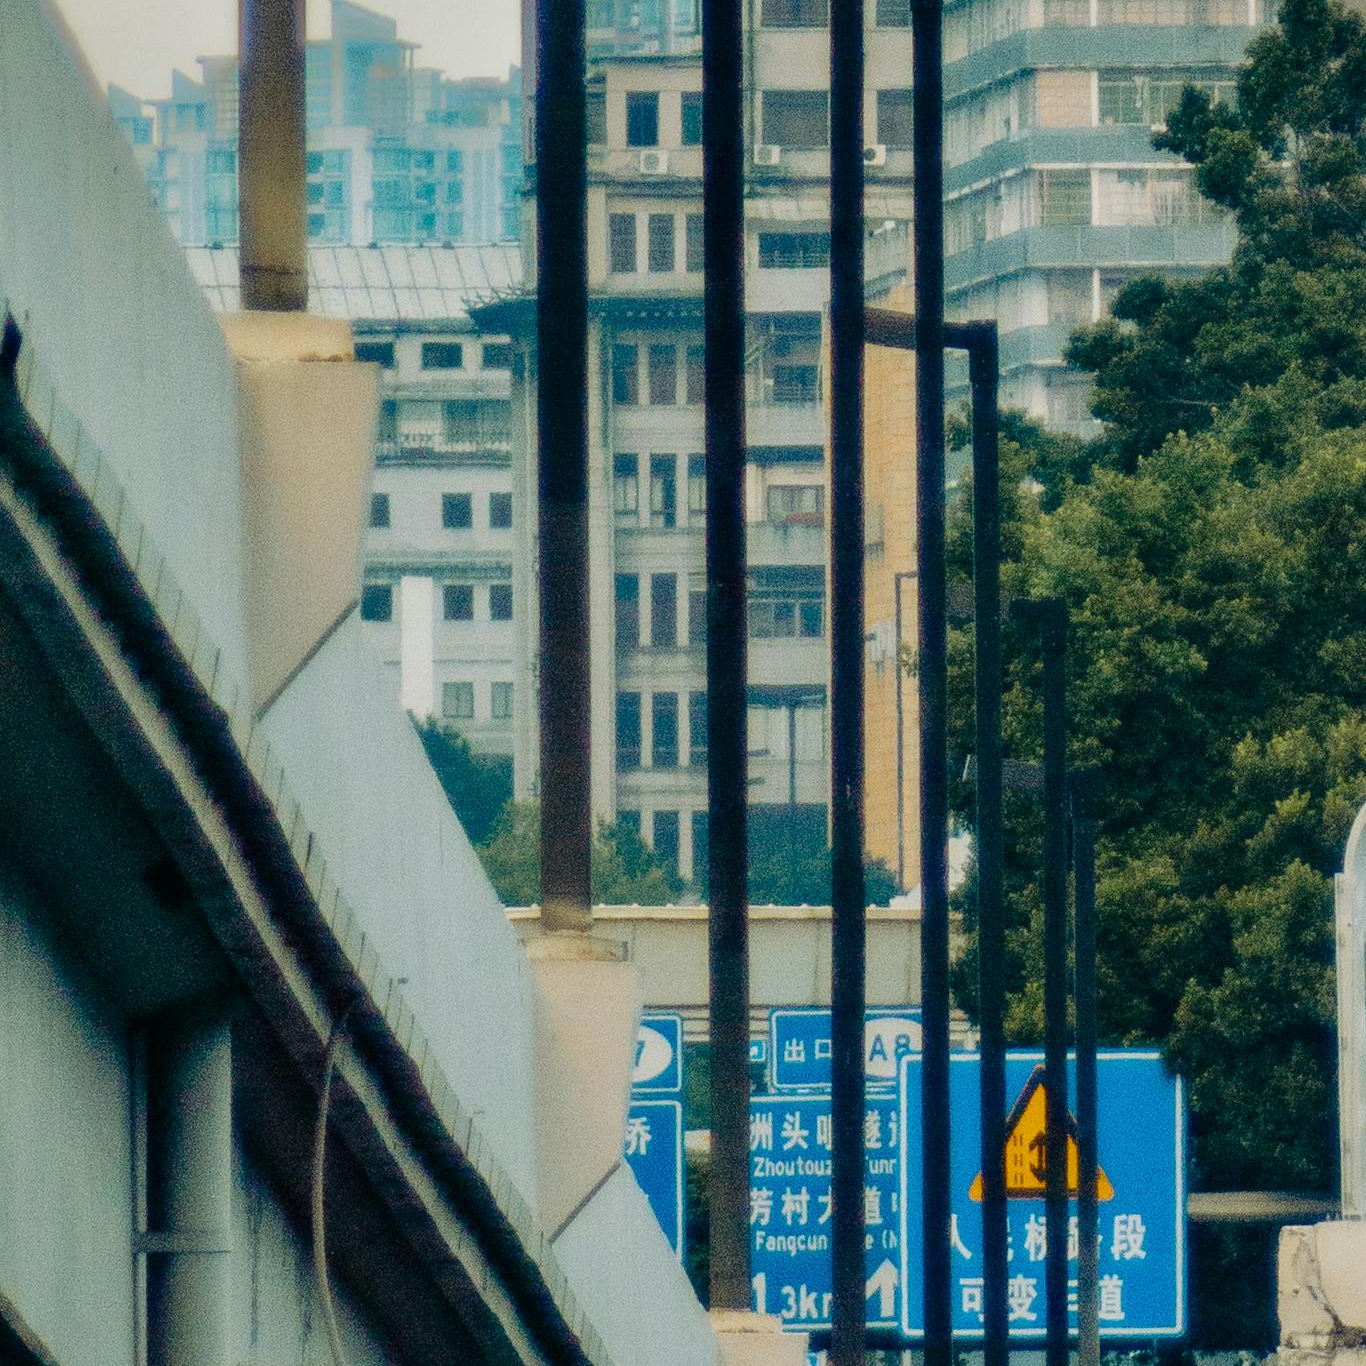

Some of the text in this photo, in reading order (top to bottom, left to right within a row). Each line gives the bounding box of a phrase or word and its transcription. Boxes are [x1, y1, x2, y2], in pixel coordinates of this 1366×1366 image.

[783, 1037, 832, 1062] 出口
[754, 1155, 832, 1178] Zhoutouz
[755, 1231, 828, 1257] Fangcun
